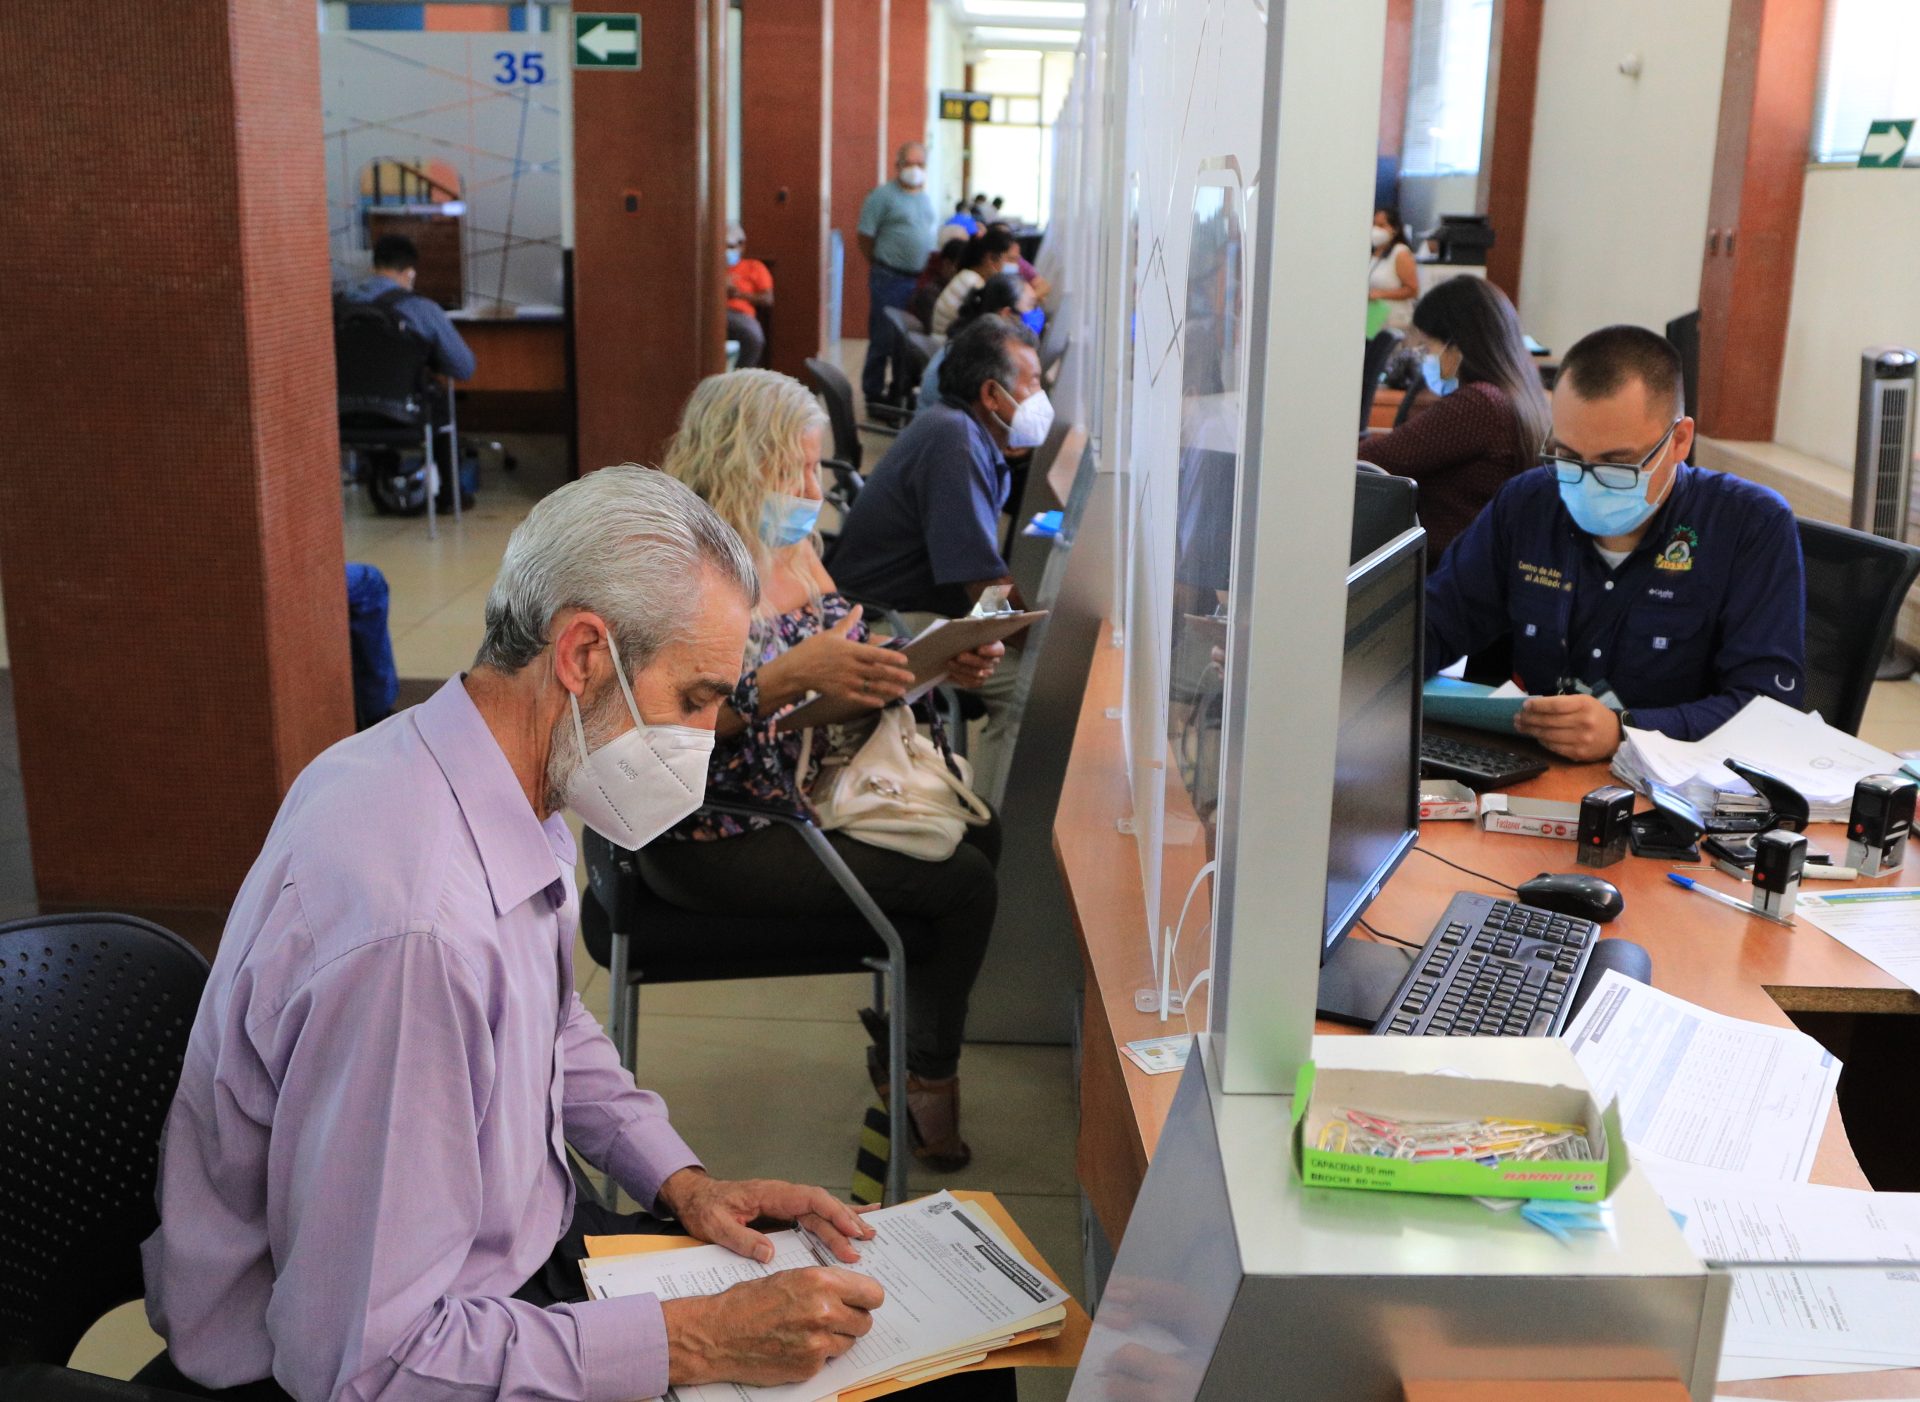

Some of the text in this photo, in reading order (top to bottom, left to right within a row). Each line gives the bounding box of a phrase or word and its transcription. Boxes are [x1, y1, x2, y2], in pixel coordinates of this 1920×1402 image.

[495, 51, 544, 84] 35
[1539, 566, 1547, 575] de
[617, 760, 638, 780] KN95
[1311, 1159, 1362, 1174] CAPACIDAD
[1379, 1168, 1395, 1176] mm
